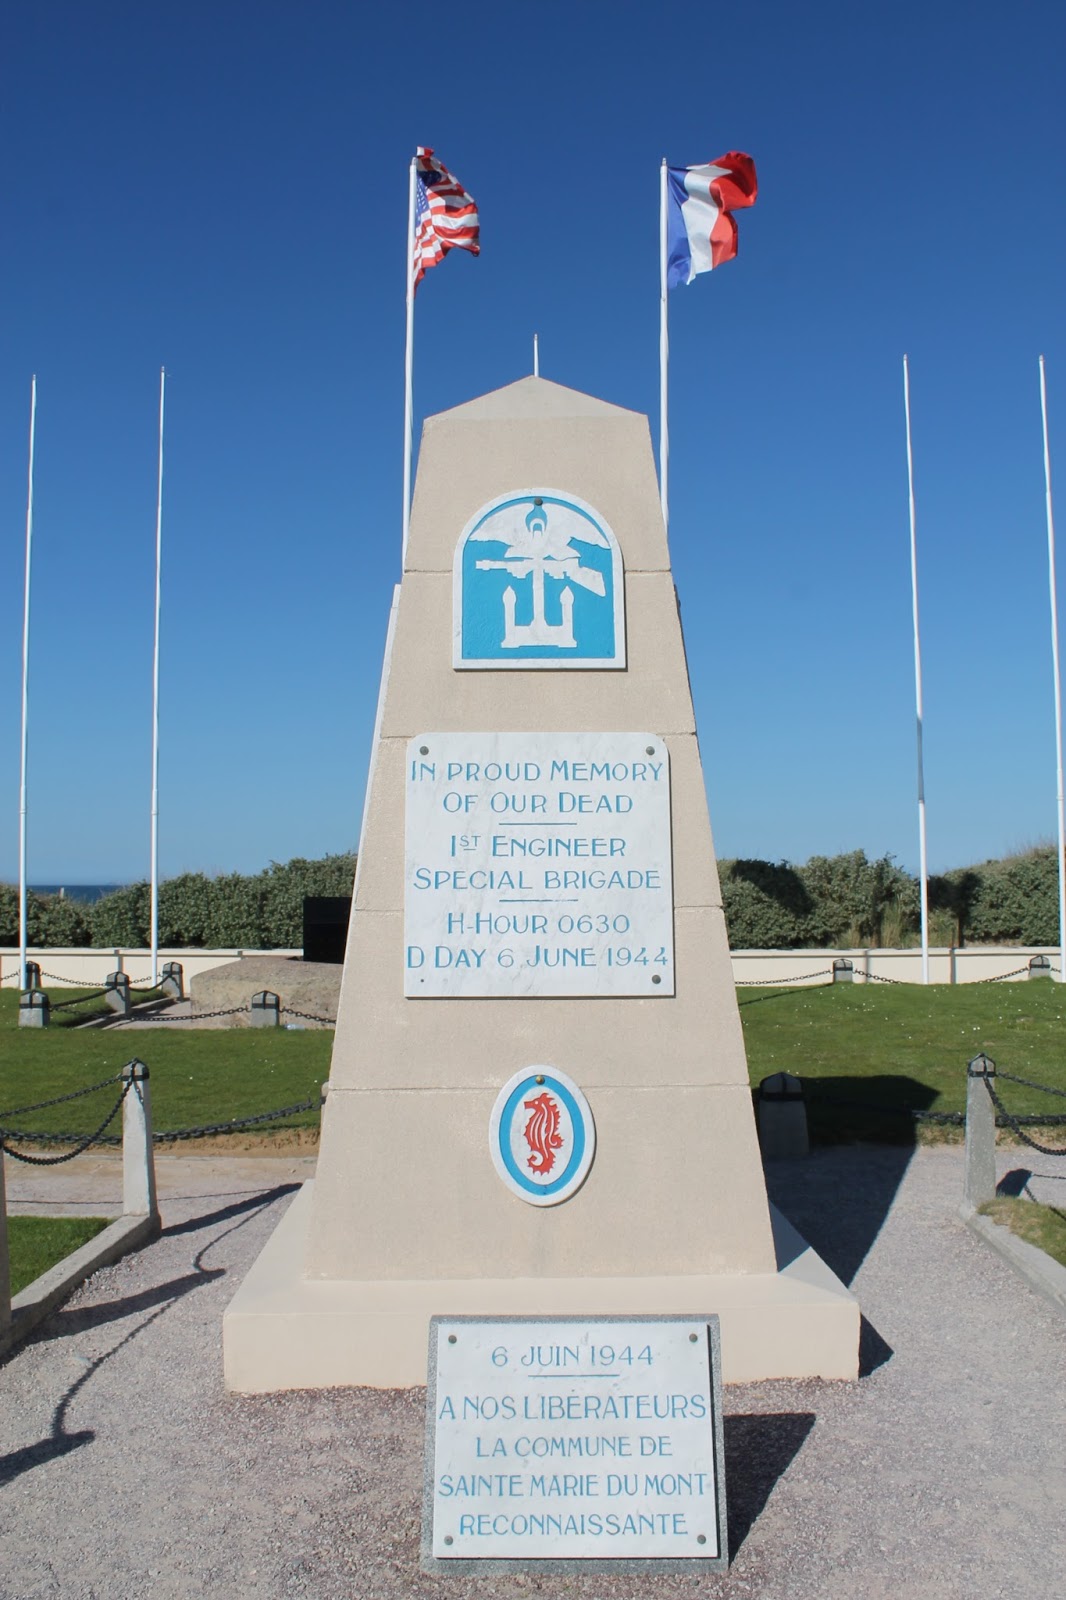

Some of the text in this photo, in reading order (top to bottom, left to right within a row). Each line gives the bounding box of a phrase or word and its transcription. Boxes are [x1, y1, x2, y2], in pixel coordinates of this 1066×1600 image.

[411, 760, 663, 781] IN PROUD MEMORY
[443, 792, 633, 813] OF OUR DEAD
[492, 836, 626, 857] ENGINEER
[413, 868, 661, 889] SPECIAL BRIGADE
[447, 912, 630, 934] H-HOUR 0630
[407, 945, 668, 968] D DAY 6 JUNE 1944
[491, 1345, 653, 1367] 6 JUIN 1944
[439, 1396, 456, 1420] A
[463, 1396, 516, 1420] NOS
[476, 1436, 672, 1457] LA COMMUNE DE
[438, 1473, 707, 1496] SAINTE MARIE DU MONT
[459, 1513, 688, 1536] RECONNAISSANTE
